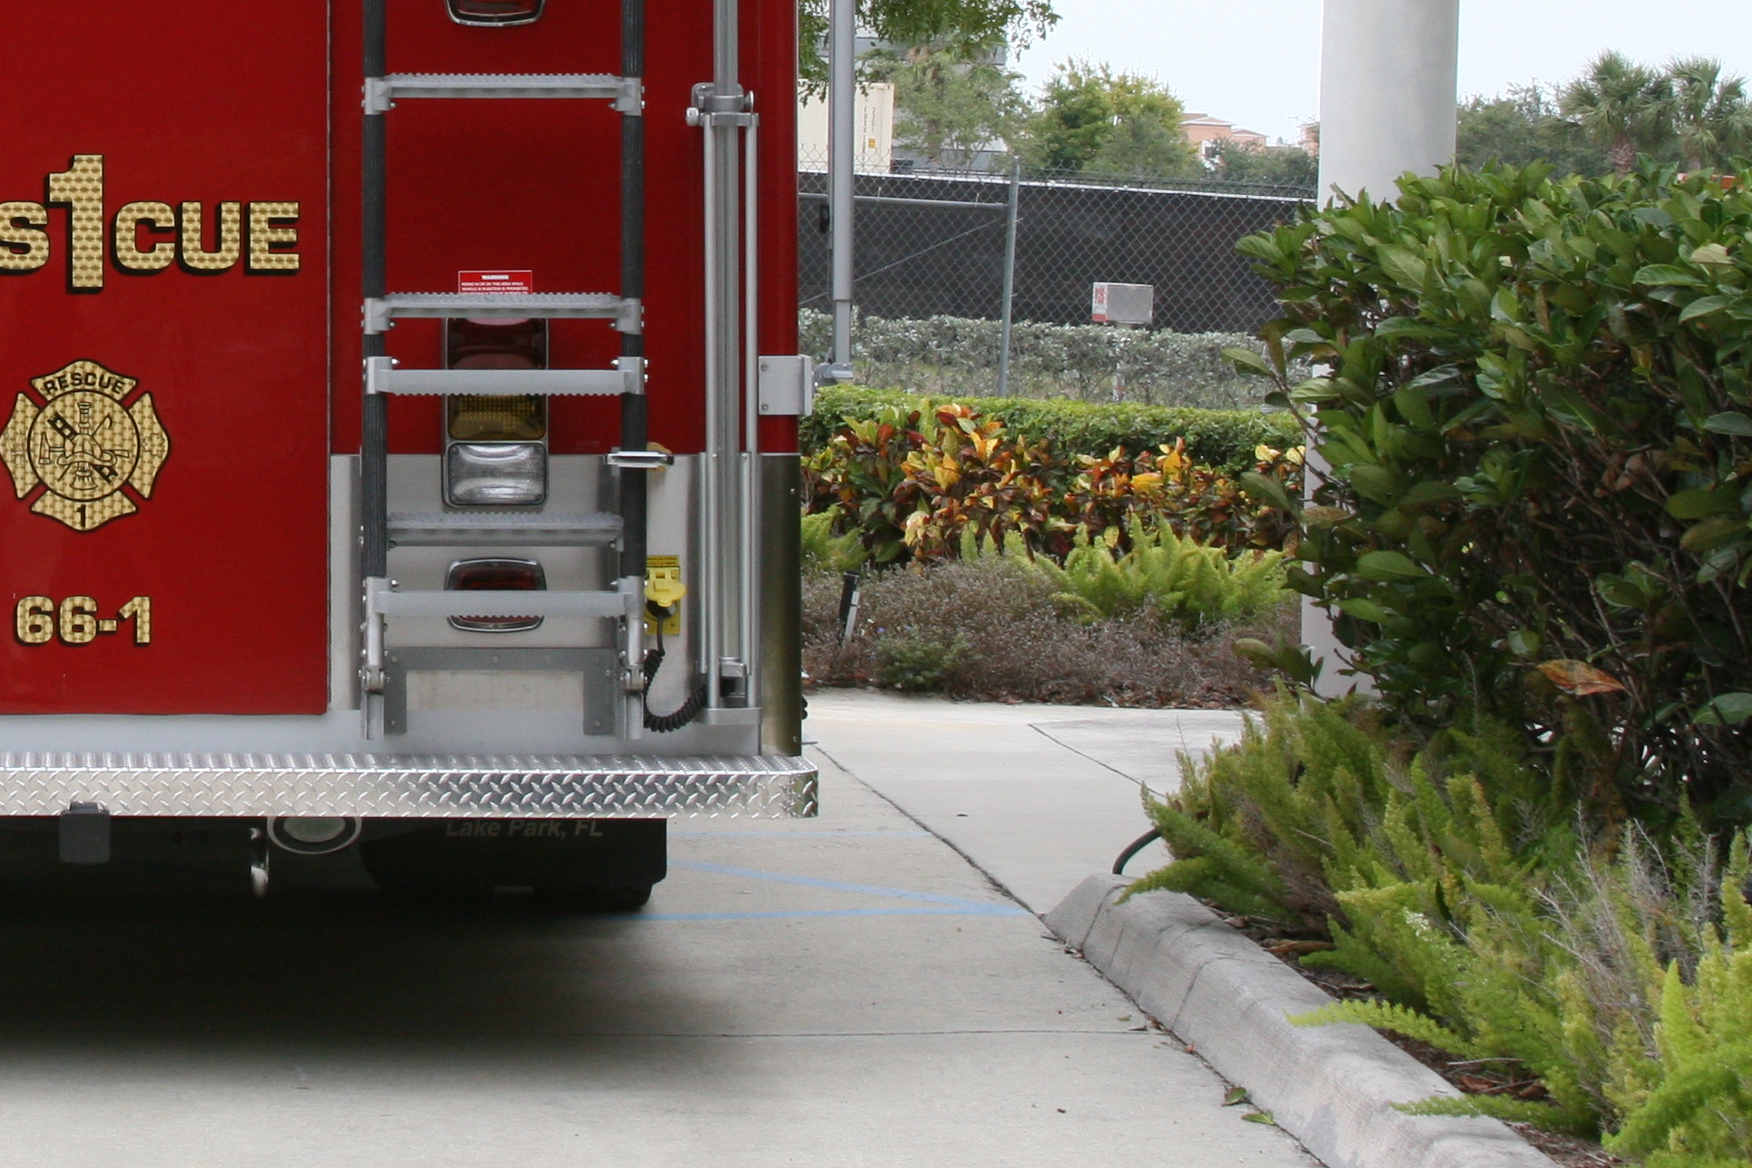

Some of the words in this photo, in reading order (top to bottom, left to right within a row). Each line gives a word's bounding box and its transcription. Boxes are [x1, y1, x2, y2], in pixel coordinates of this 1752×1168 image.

[43, 372, 126, 395] RESCUE
[76, 504, 86, 528] 1
[14, 595, 151, 646] 66-1
[446, 819, 501, 837] Lake
[574, 819, 604, 837] FL
